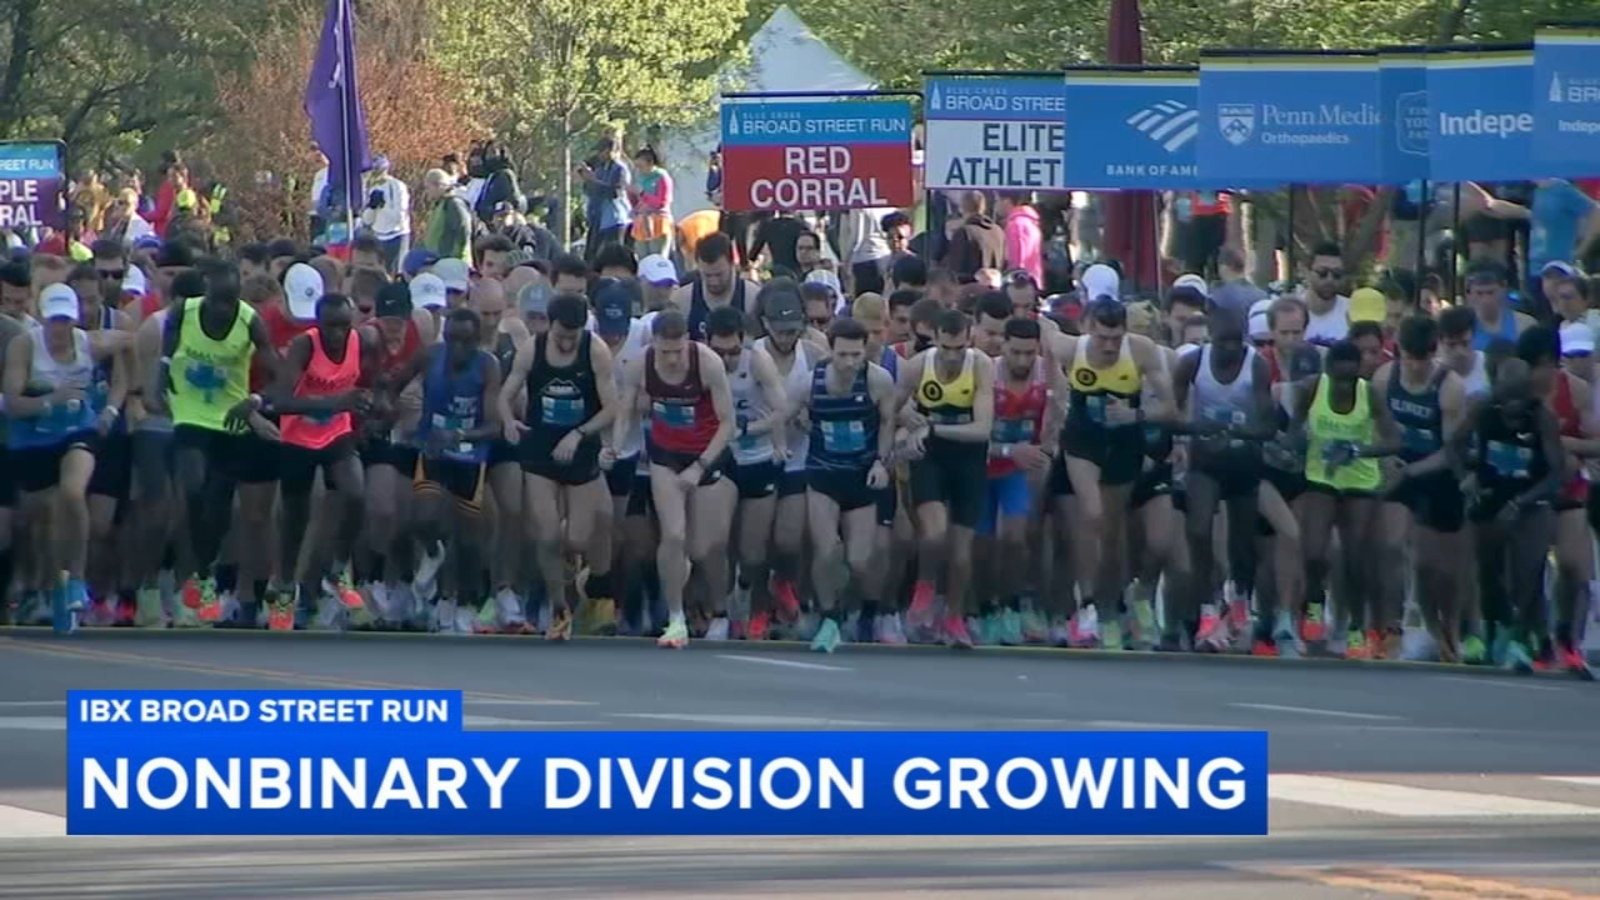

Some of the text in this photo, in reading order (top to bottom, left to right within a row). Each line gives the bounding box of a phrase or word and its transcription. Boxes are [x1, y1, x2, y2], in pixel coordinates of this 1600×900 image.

[945, 95, 1007, 111] BROAD
[1262, 103, 1315, 125] Penn
[742, 117, 906, 134] BROAD STREET RUN
[1440, 109, 1533, 139] Indepe
[983, 123, 1065, 152] ELITE
[1261, 131, 1349, 146] Orthopaedics
[29, 159, 54, 170] RUN
[785, 147, 851, 174] RED
[1106, 164, 1145, 176] BANK
[1148, 164, 1167, 176] OF
[945, 157, 1062, 187] ATHLET
[751, 178, 888, 208] CORRAL
